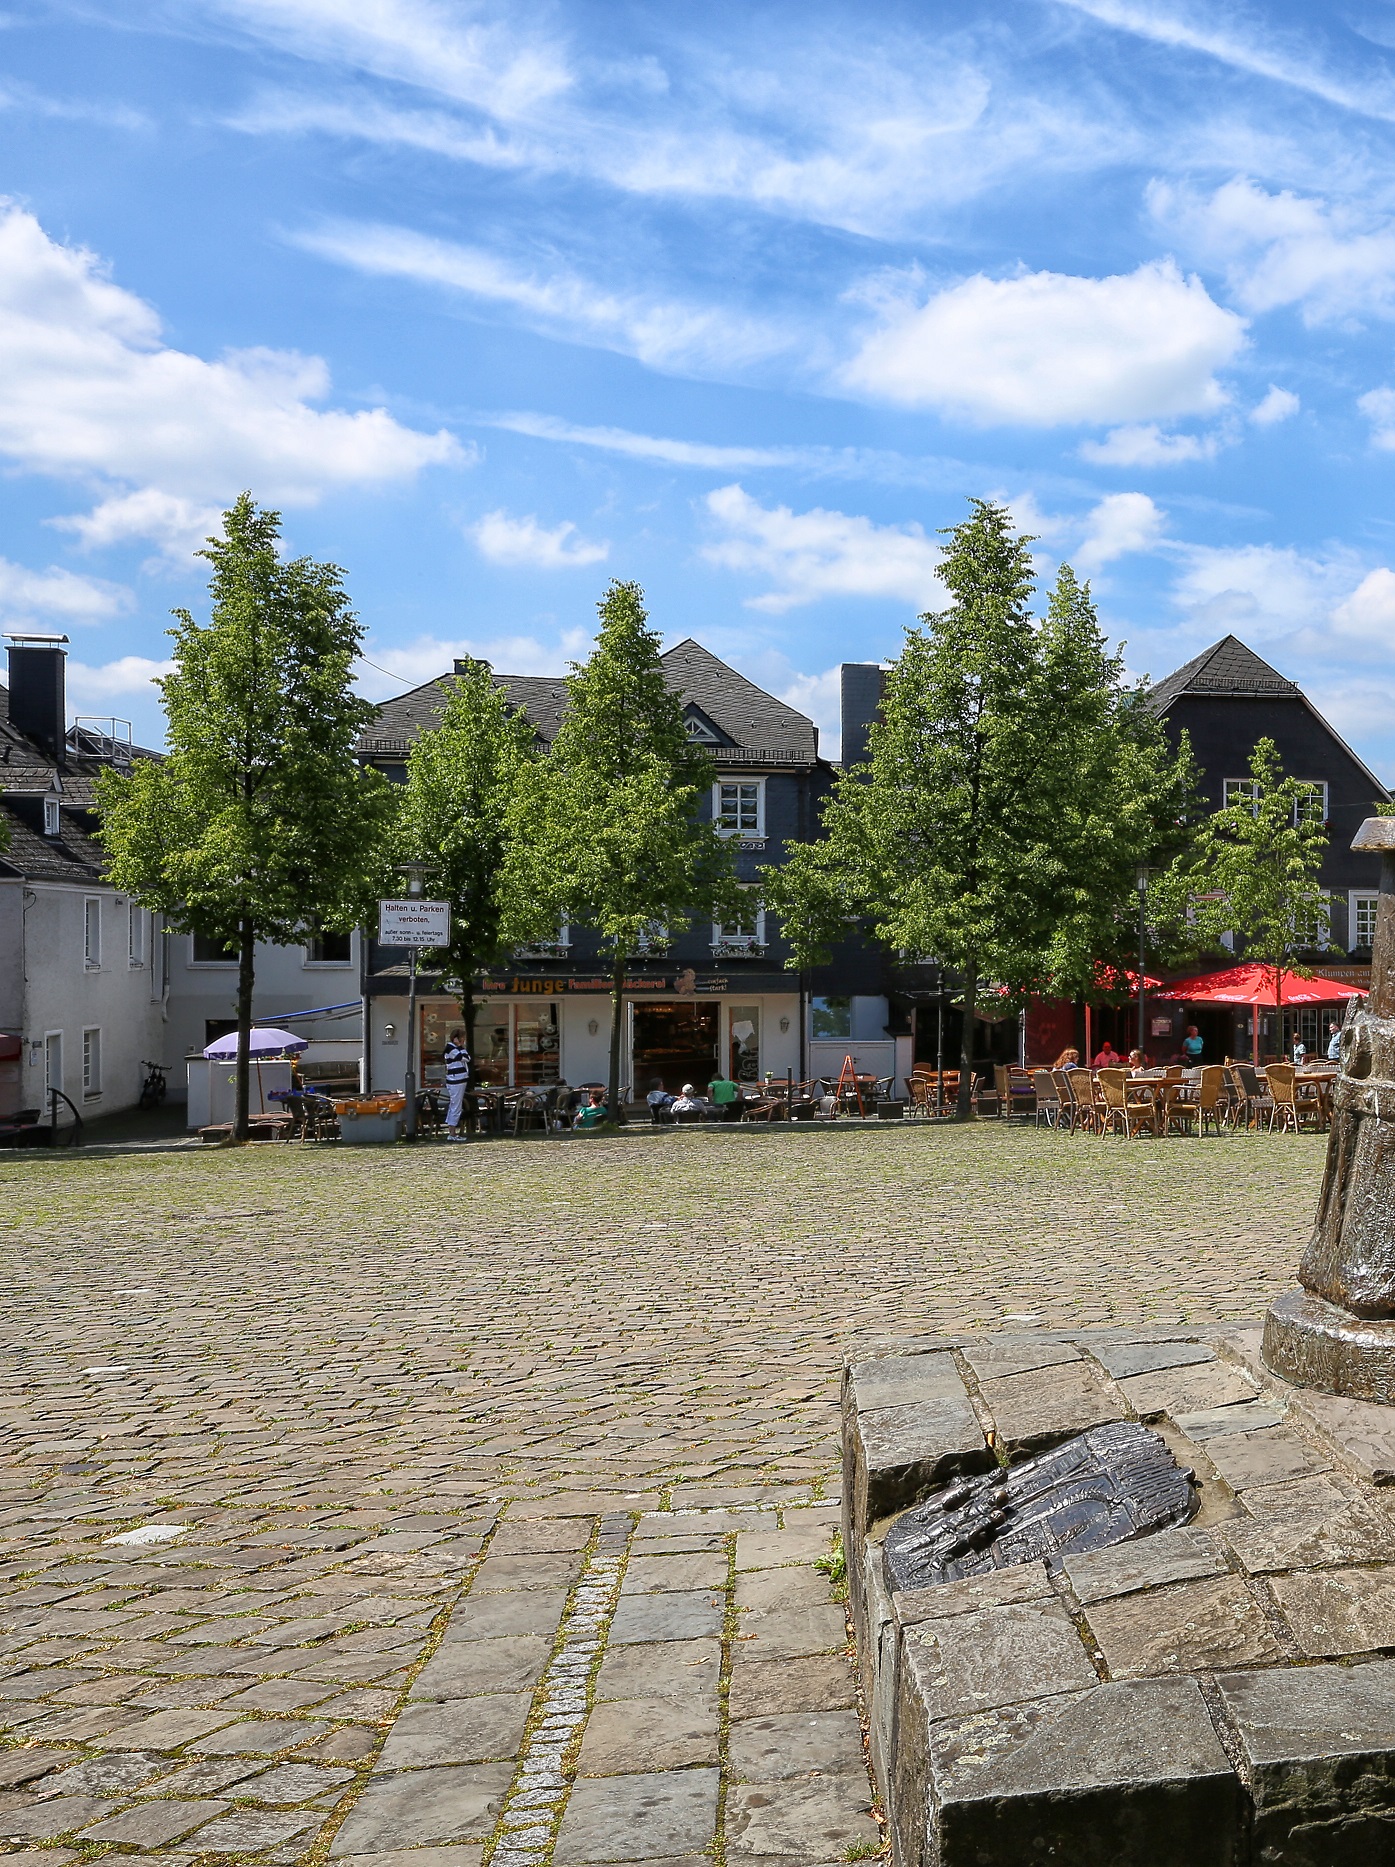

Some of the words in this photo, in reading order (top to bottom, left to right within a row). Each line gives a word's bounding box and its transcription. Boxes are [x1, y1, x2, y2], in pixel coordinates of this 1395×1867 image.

[385, 904, 408, 912] Halten
[419, 904, 444, 912] Parken
[511, 977, 564, 995] Junge
